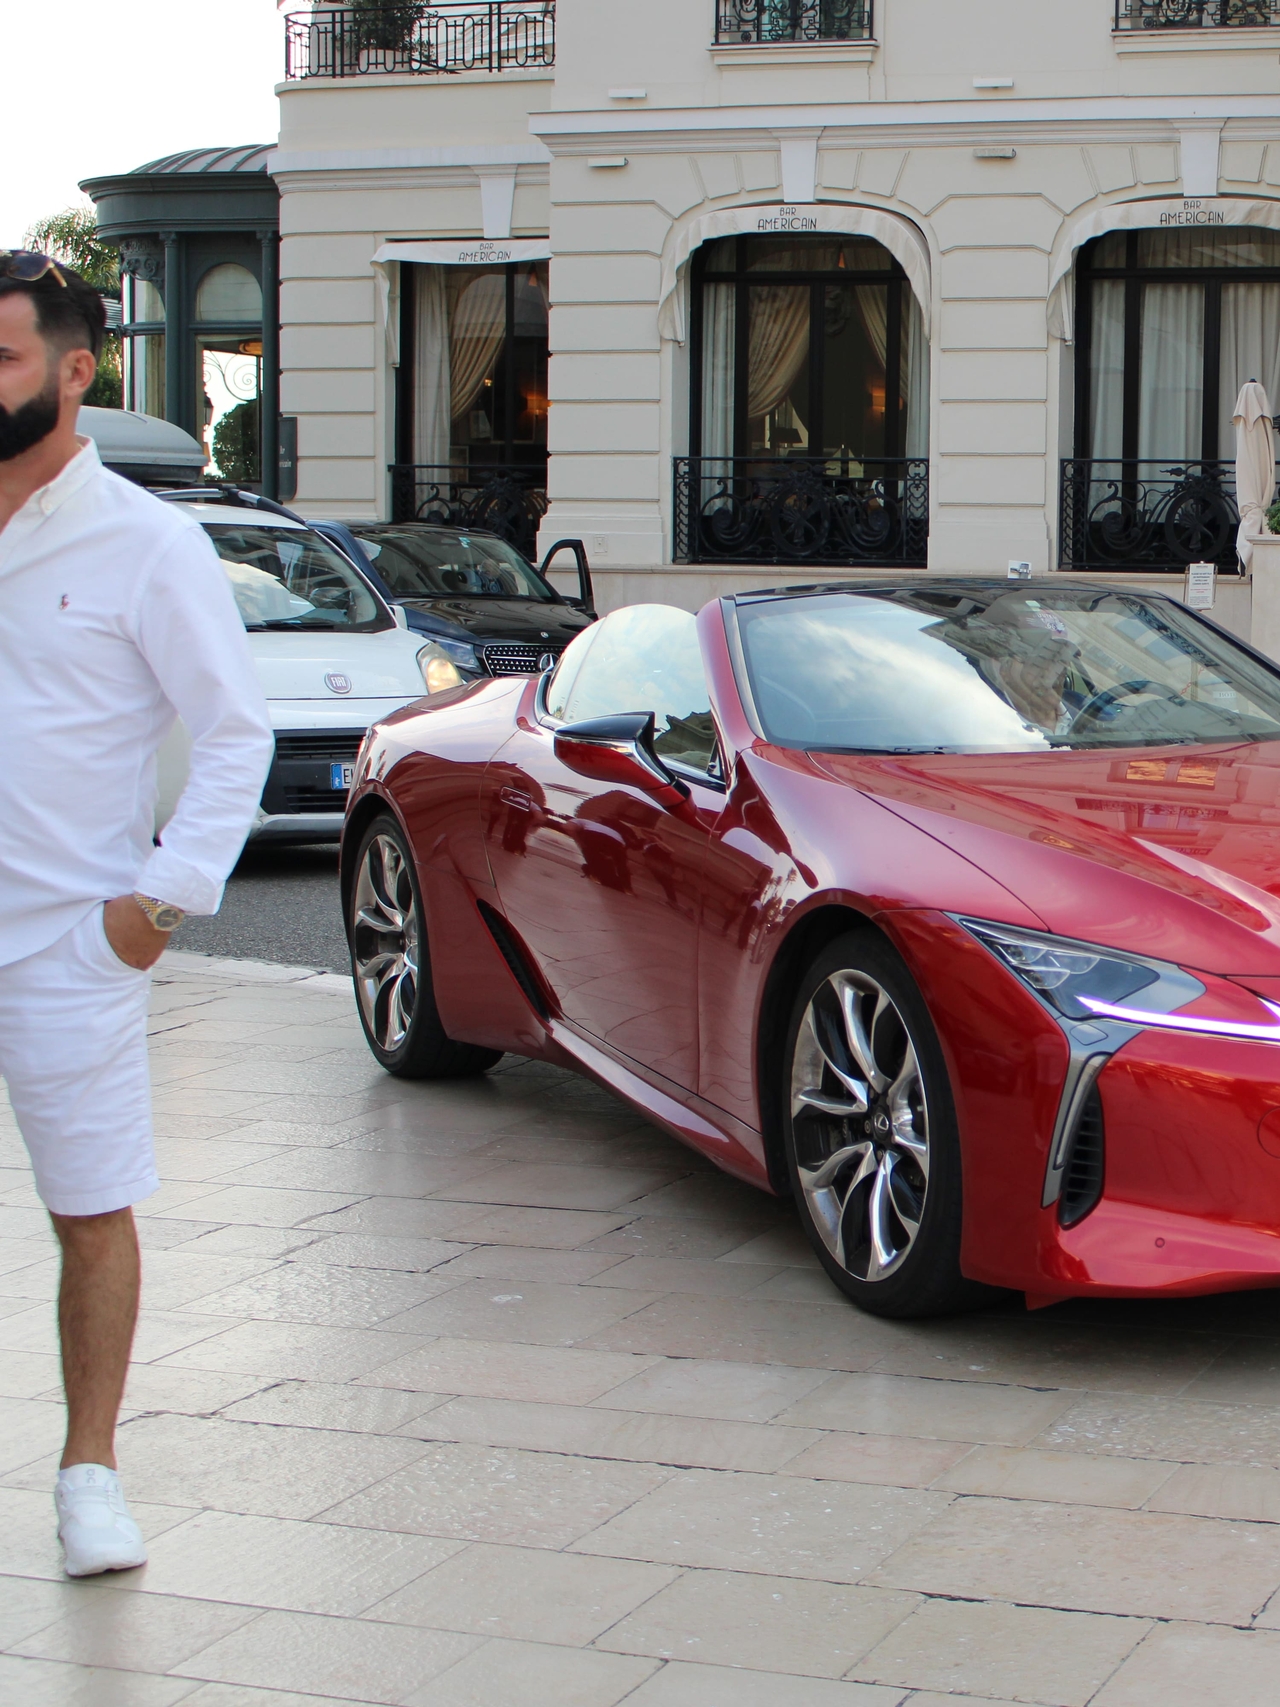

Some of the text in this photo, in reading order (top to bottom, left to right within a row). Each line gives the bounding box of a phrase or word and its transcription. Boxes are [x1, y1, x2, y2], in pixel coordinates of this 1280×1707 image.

[1183, 200, 1201, 210] BAR
[779, 207, 796, 217] BAR
[1160, 211, 1224, 225] AMERICAIN
[757, 217, 817, 231] AMERICAIN
[479, 243, 494, 251] BAR
[458, 251, 512, 263] AMERICAIN
[330, 677, 347, 687] FIAT
